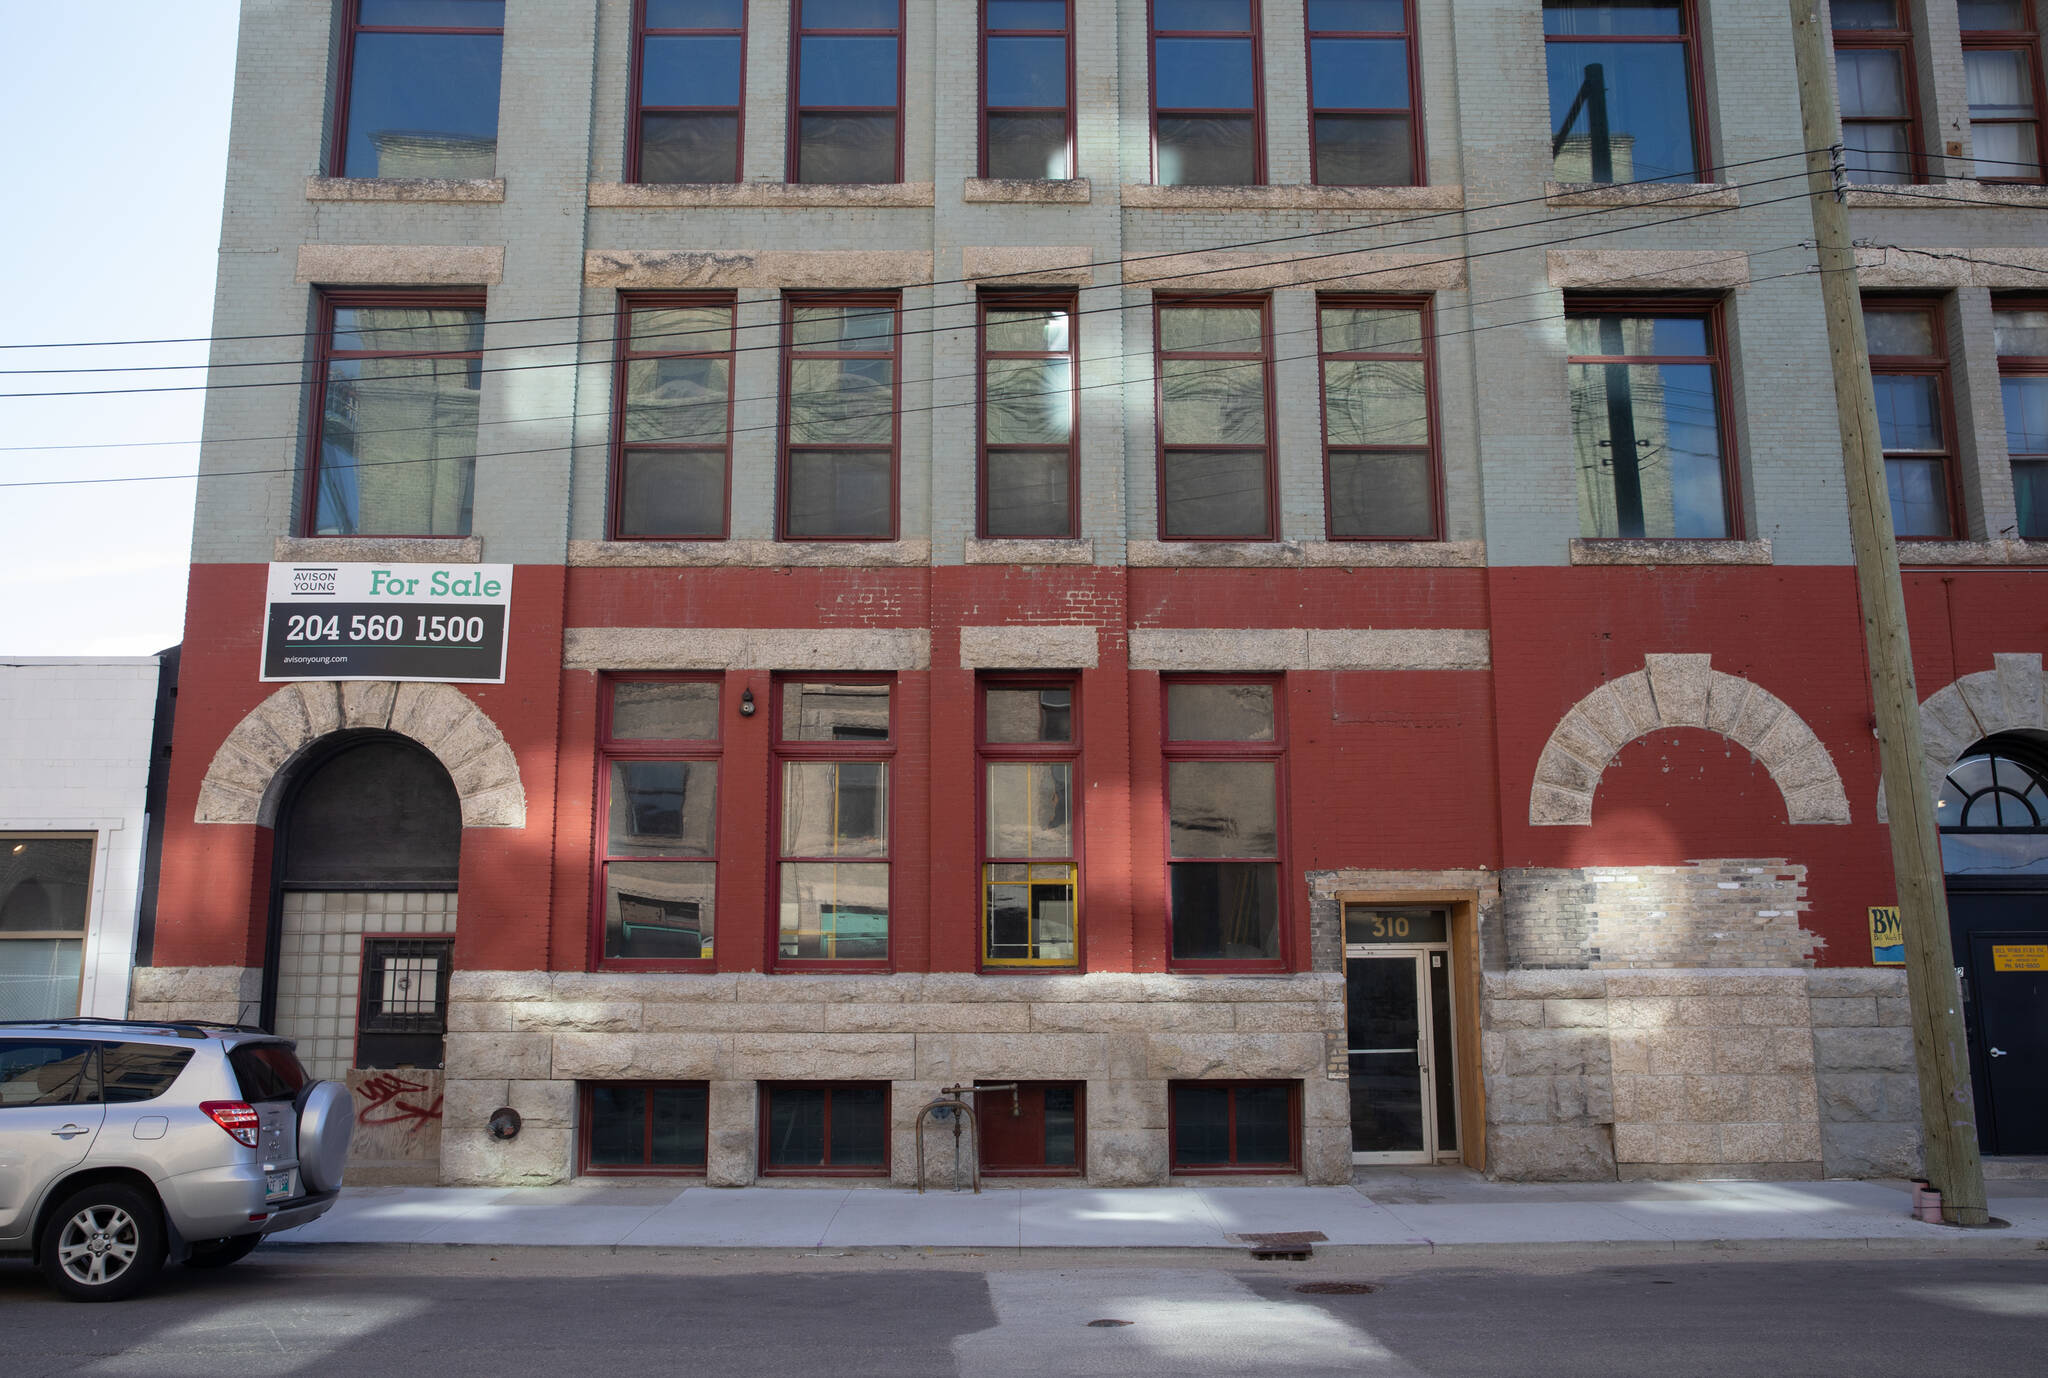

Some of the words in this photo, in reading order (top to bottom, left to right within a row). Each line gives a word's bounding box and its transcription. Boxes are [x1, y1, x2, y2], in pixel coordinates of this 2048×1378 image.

[294, 572, 336, 581] AVISON
[369, 570, 420, 596] For
[430, 570, 502, 597] Sale
[293, 582, 335, 591] YOUNG
[286, 615, 341, 641] 204
[349, 615, 404, 641] 560
[415, 615, 484, 643] 1500
[283, 655, 348, 665] avisonyoung.com
[1372, 917, 1409, 937] 310
